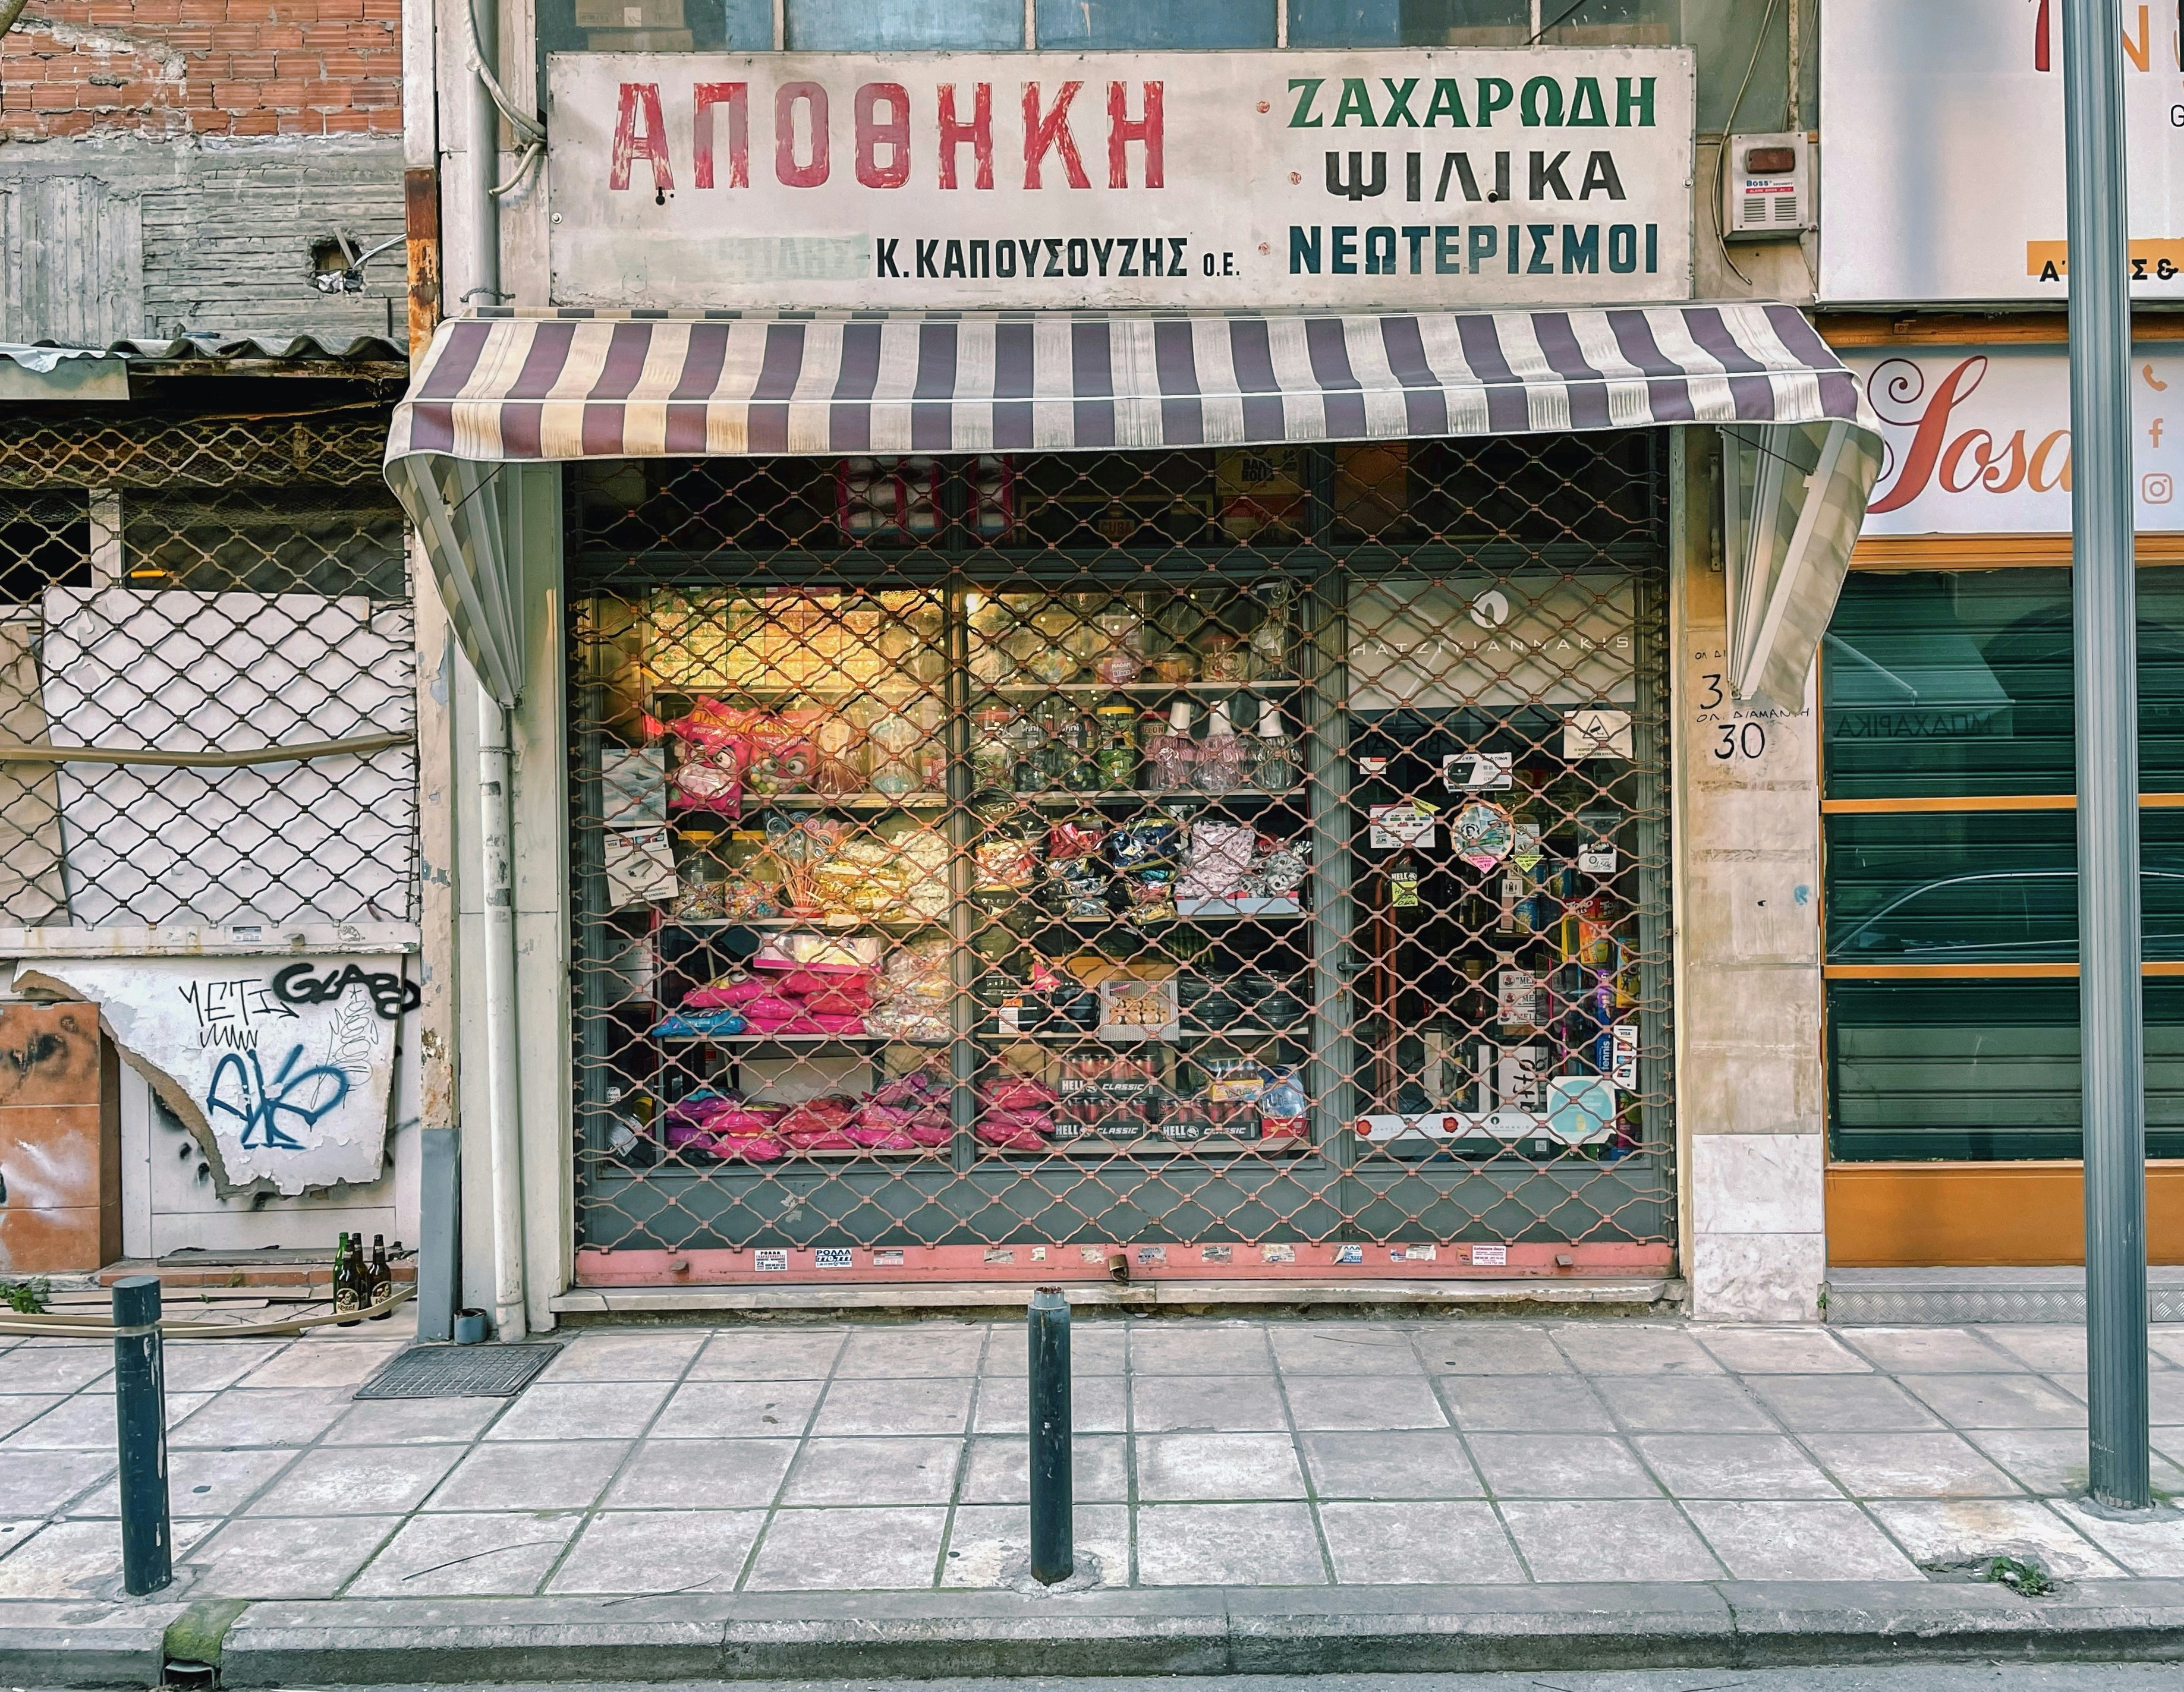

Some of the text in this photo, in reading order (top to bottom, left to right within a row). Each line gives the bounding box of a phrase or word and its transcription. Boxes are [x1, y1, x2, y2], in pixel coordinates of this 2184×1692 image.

[1286, 75, 1658, 128] ΖΑΧΑΡΩΔΗ
[609, 80, 1165, 191] ΑΠΟΘΗΚΗ
[1325, 150, 1626, 203] ΨΙΛΙΚΑ
[1288, 223, 1659, 276] ΝΕΩΤΕΡΙΣΜΟΙ
[1353, 637, 1629, 656] HATZIYIANNAKIS
[1733, 707, 1809, 719] ΔΙΑΜΑΝΗ
[1714, 722, 1766, 759] 30
[1600, 1040, 1610, 1072] tennis
[1062, 1079, 1145, 1091] HELL CLASSIC
[1056, 1124, 1138, 1136] HELL CLASSIC
[1163, 1125, 1187, 1136] HELL
